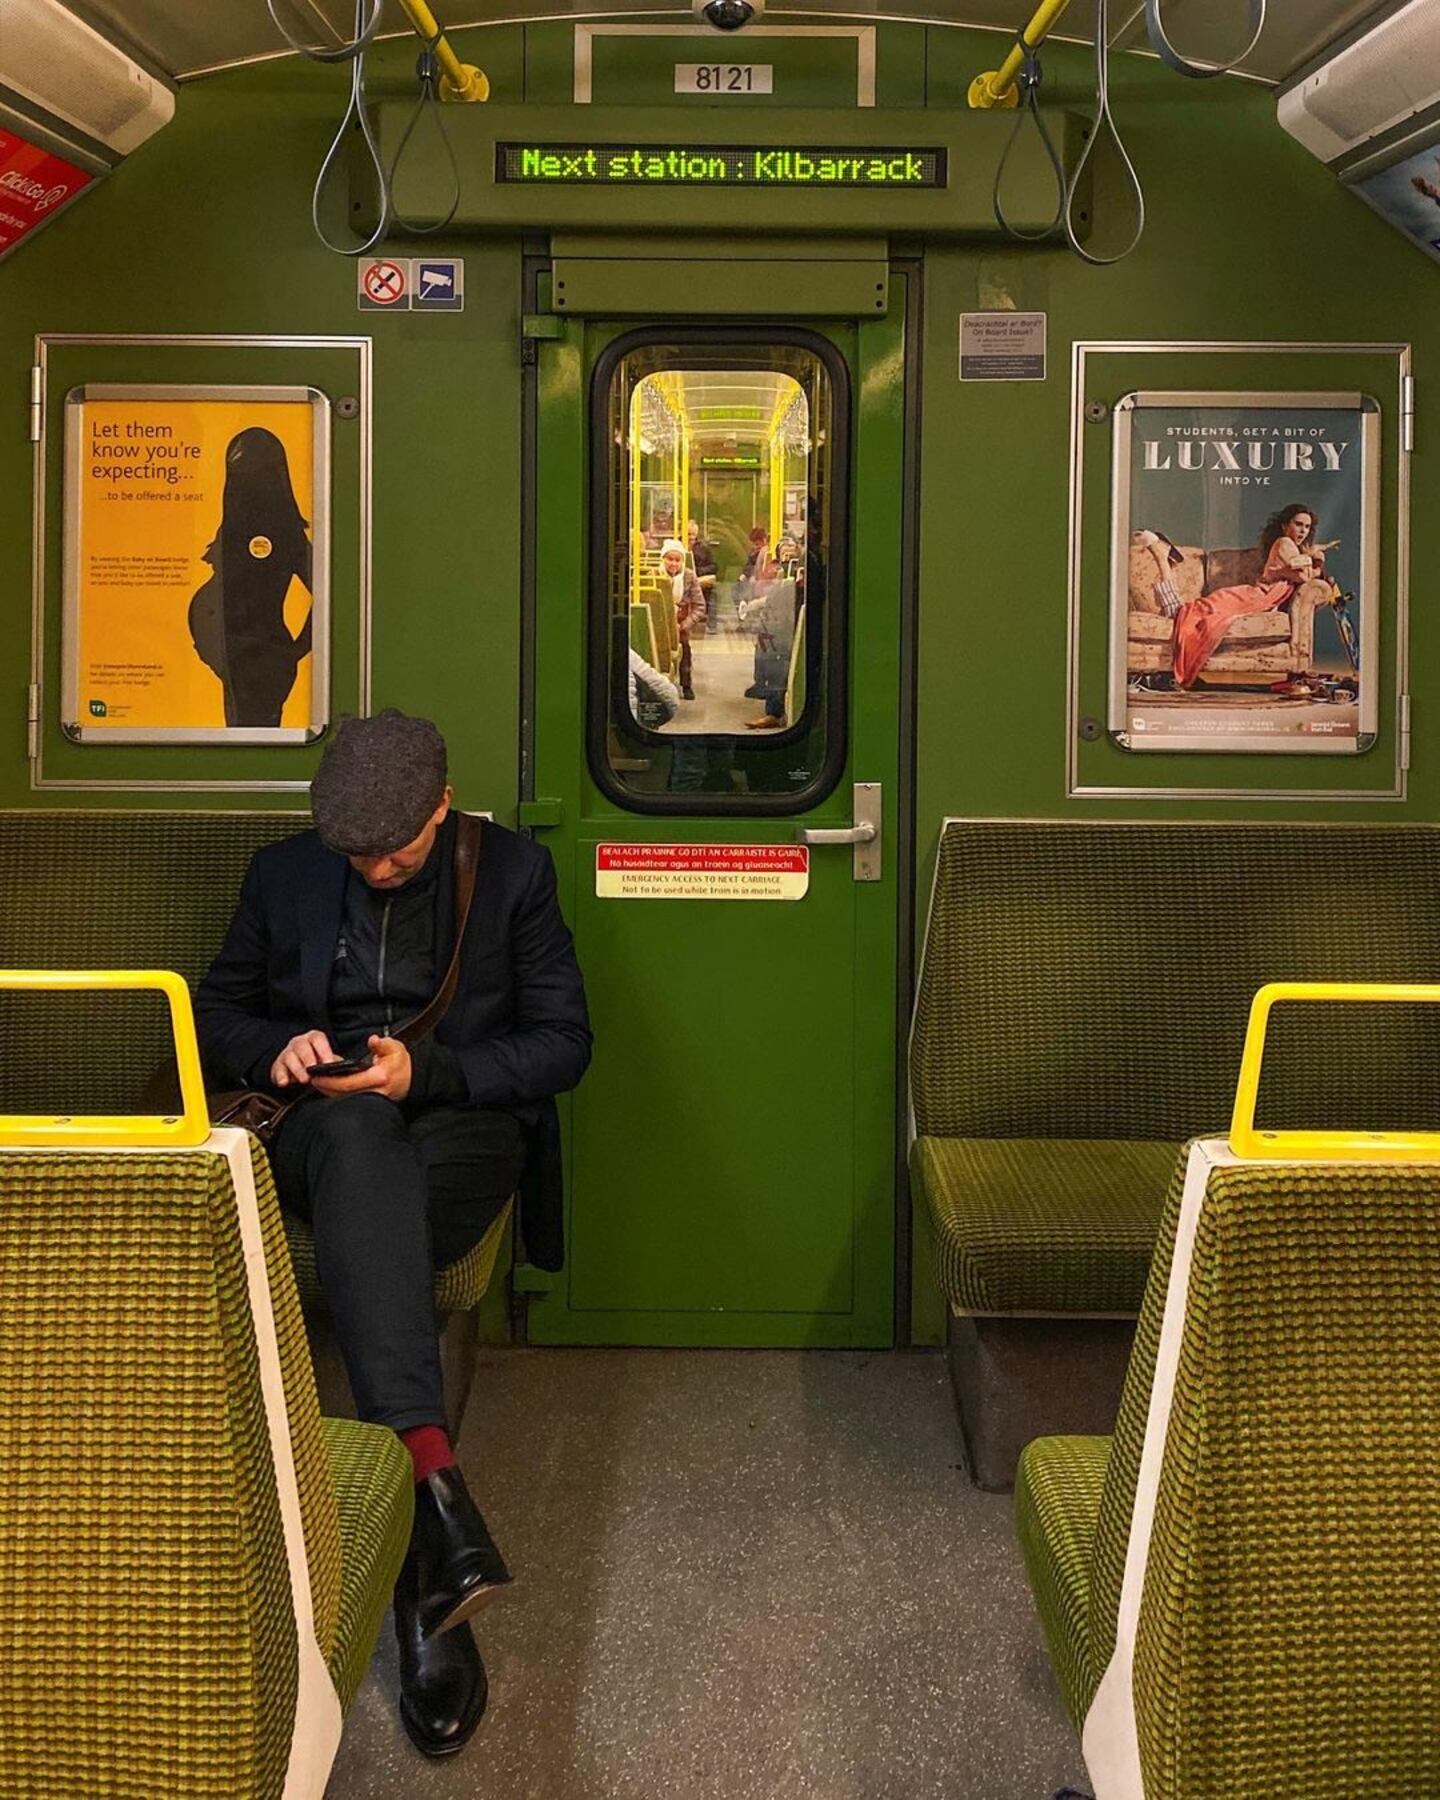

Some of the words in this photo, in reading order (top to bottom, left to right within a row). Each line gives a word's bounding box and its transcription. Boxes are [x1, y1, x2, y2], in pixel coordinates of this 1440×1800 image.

[696, 66, 753, 91] 8121
[522, 149, 598, 177] Next
[608, 150, 726, 178] station
[755, 152, 923, 180] Kilbarrack
[92, 421, 119, 438] Let
[126, 420, 173, 438] them
[1166, 427, 1238, 437] STUDENTS,
[1243, 427, 1268, 436] GET
[1272, 428, 1280, 436] A
[1284, 428, 1305, 437] BIT
[1309, 428, 1327, 437] OF
[92, 441, 141, 458] know
[146, 441, 201, 463] you're
[1142, 440, 1348, 471] LUXURY
[92, 462, 194, 484] expecting...
[1220, 477, 1250, 485] INTO
[1255, 477, 1271, 485] YE
[121, 492, 134, 501] be
[136, 492, 171, 501] offered
[183, 493, 204, 502] seat
[678, 848, 690, 856] GO
[708, 849, 721, 857] AN
[769, 849, 776, 857] IS
[622, 875, 669, 883] EMERGENCY
[672, 875, 703, 883] ACCESS
[741, 876, 780, 884] CARRIAGE
[622, 886, 637, 894] Not
[640, 886, 649, 894] to
[652, 886, 662, 894] be
[664, 886, 683, 894] used
[685, 886, 708, 894] while
[710, 887, 730, 895] train
[733, 887, 739, 895] is
[741, 887, 749, 895] in
[751, 887, 782, 895] motion
